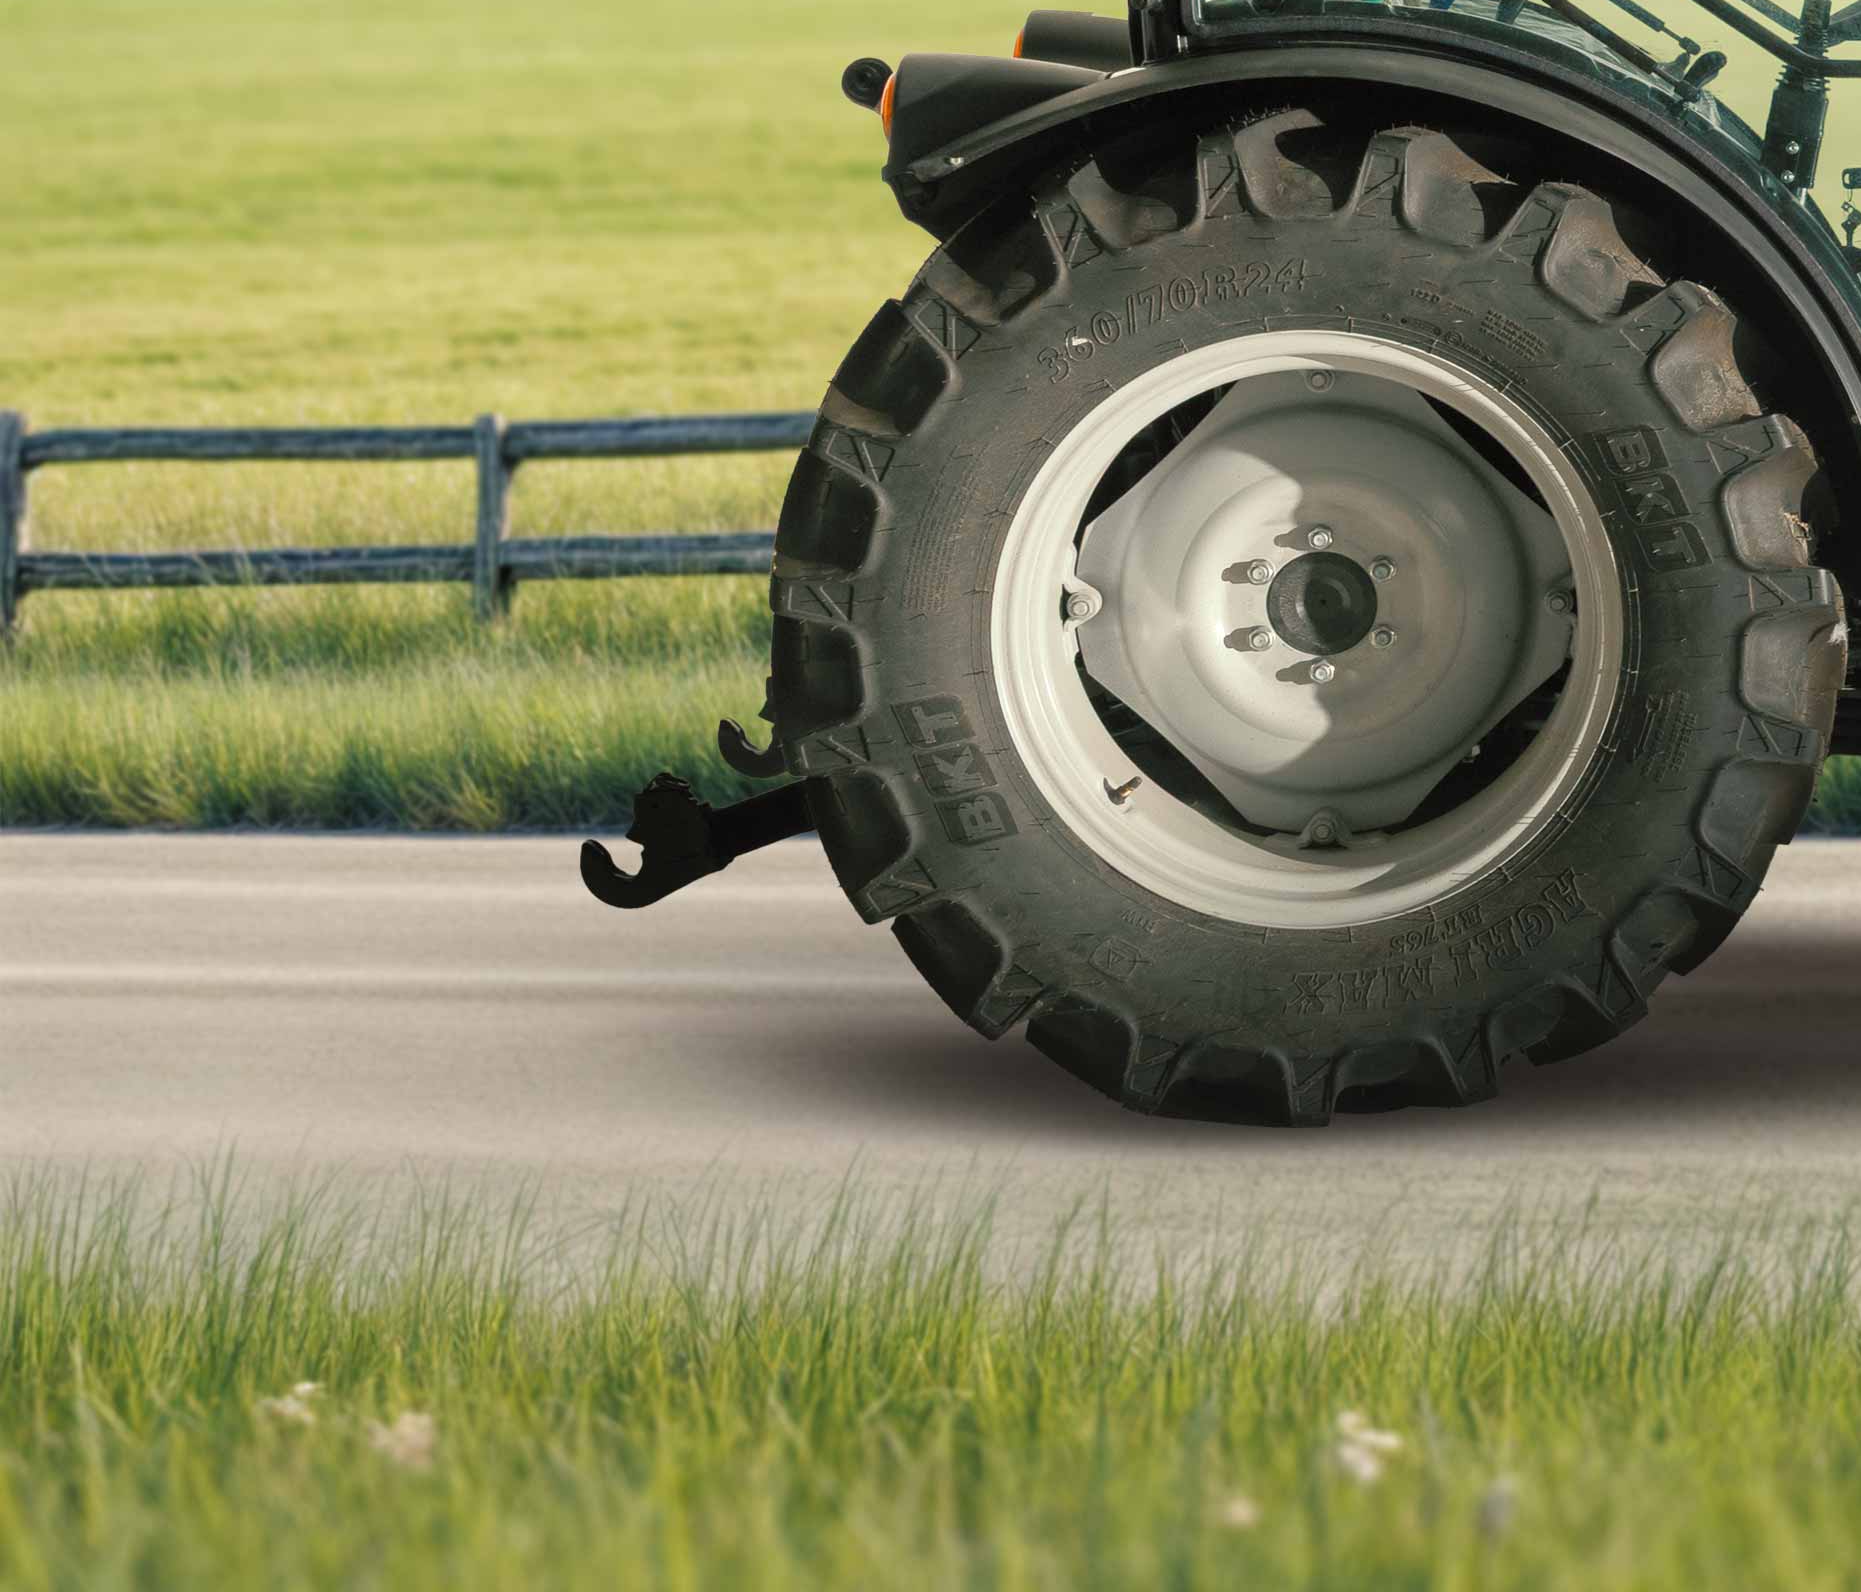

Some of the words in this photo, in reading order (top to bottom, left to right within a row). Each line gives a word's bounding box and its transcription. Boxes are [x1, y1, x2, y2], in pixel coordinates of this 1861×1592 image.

[1605, 429, 1698, 565] BKT
[909, 704, 1007, 841] BKT
[1282, 954, 1437, 1015] MAX
[1389, 924, 1440, 954] 765
[1450, 864, 1587, 986] AGRI
